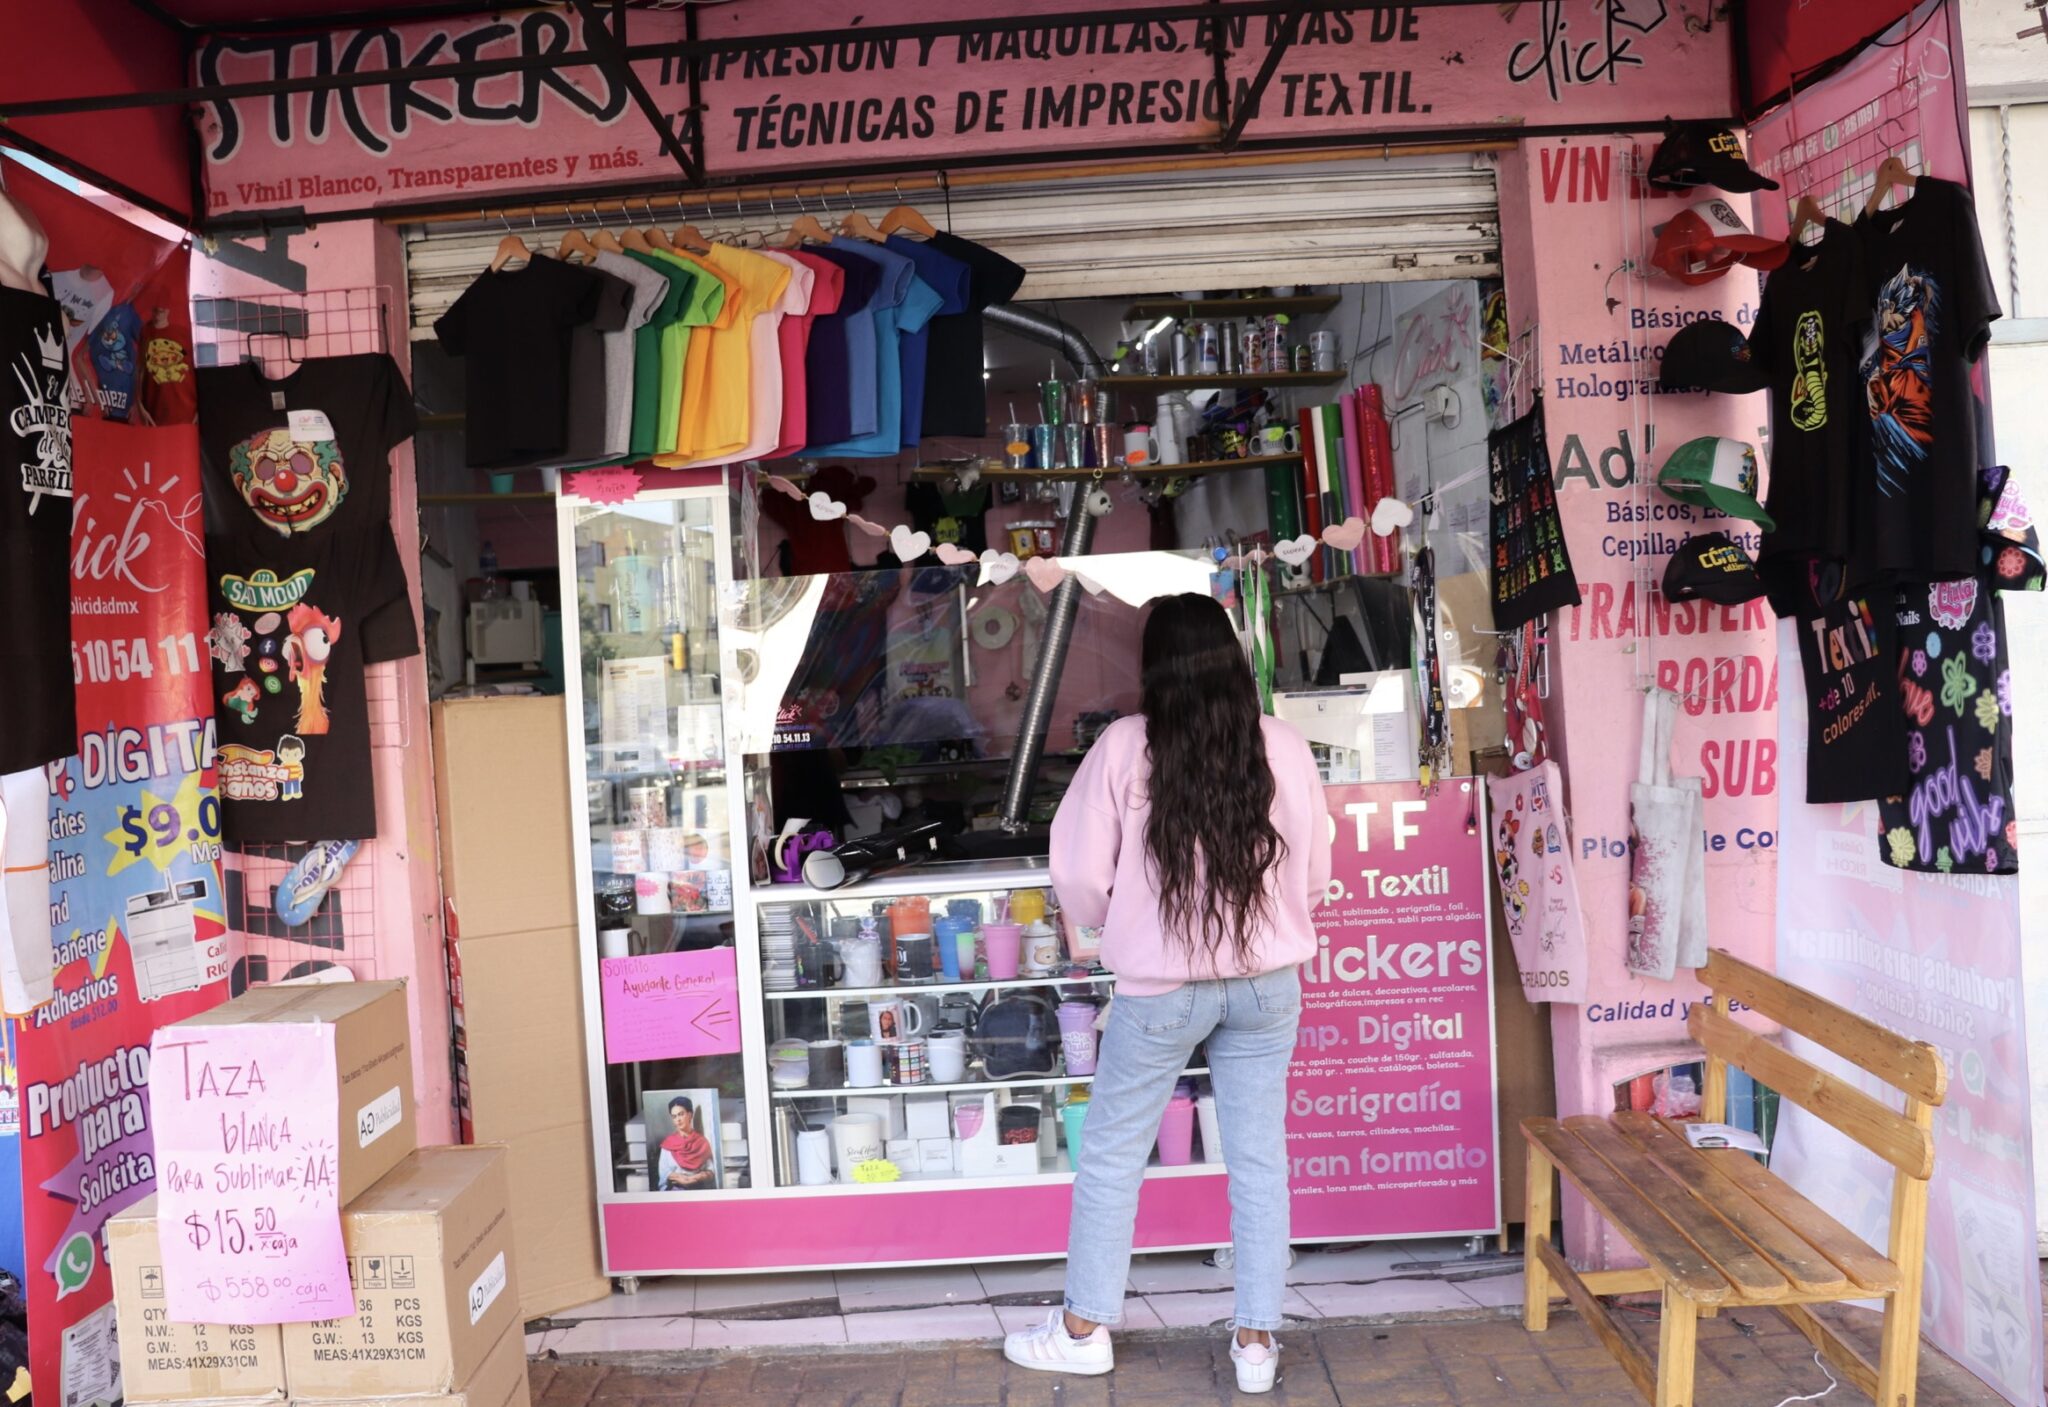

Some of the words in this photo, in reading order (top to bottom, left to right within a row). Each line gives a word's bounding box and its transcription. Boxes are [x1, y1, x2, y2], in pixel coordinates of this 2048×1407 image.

[1370, 6, 1419, 42] DE
[734, 94, 935, 152] TÉCNICAS
[955, 89, 1007, 134] DE
[1281, 71, 1433, 117] TEXTIL.
[238, 177, 293, 205] Vinil
[298, 172, 383, 200] Blanco,
[388, 155, 557, 189] Transparentes
[565, 154, 579, 177] y
[588, 146, 644, 170] más.
[97, 384, 128, 410] pieza
[1607, 500, 1696, 523] Básicos,
[259, 576, 307, 606] MOOD
[1570, 580, 1766, 641] TRANSFER
[1840, 672, 1855, 698] 10
[228, 777, 275, 796] años
[1361, 865, 1449, 899] Textil
[1421, 914, 1443, 926] para
[36, 974, 118, 1029] Adhesivos
[1302, 990, 1326, 999] mesa
[1328, 989, 1340, 998] de
[1587, 999, 1674, 1023] Calidad
[1358, 1012, 1463, 1051] Digital
[1306, 1068, 1323, 1077] 300
[1347, 1055, 1379, 1065] couche
[1381, 1054, 1392, 1063] de
[1290, 1081, 1462, 1123] Serigrafía
[82, 1092, 146, 1164] para
[1360, 1143, 1487, 1175] formato
[80, 1153, 155, 1214] Solicita
[1326, 1184, 1346, 1194] lona
[1458, 1177, 1478, 1186] más
[359, 1300, 373, 1312] 36
[395, 1299, 420, 1311] PCS
[145, 1325, 175, 1338] N.W.:
[193, 1325, 206, 1336] 12
[229, 1324, 254, 1335] KGS
[360, 1316, 373, 1329] 12
[397, 1315, 422, 1328] KGS
[147, 1341, 177, 1354] G.W.:
[195, 1340, 208, 1352] 13
[231, 1339, 255, 1352] KGS
[312, 1333, 343, 1346] G.W.:
[362, 1333, 375, 1345] 13
[398, 1332, 423, 1344] KGS
